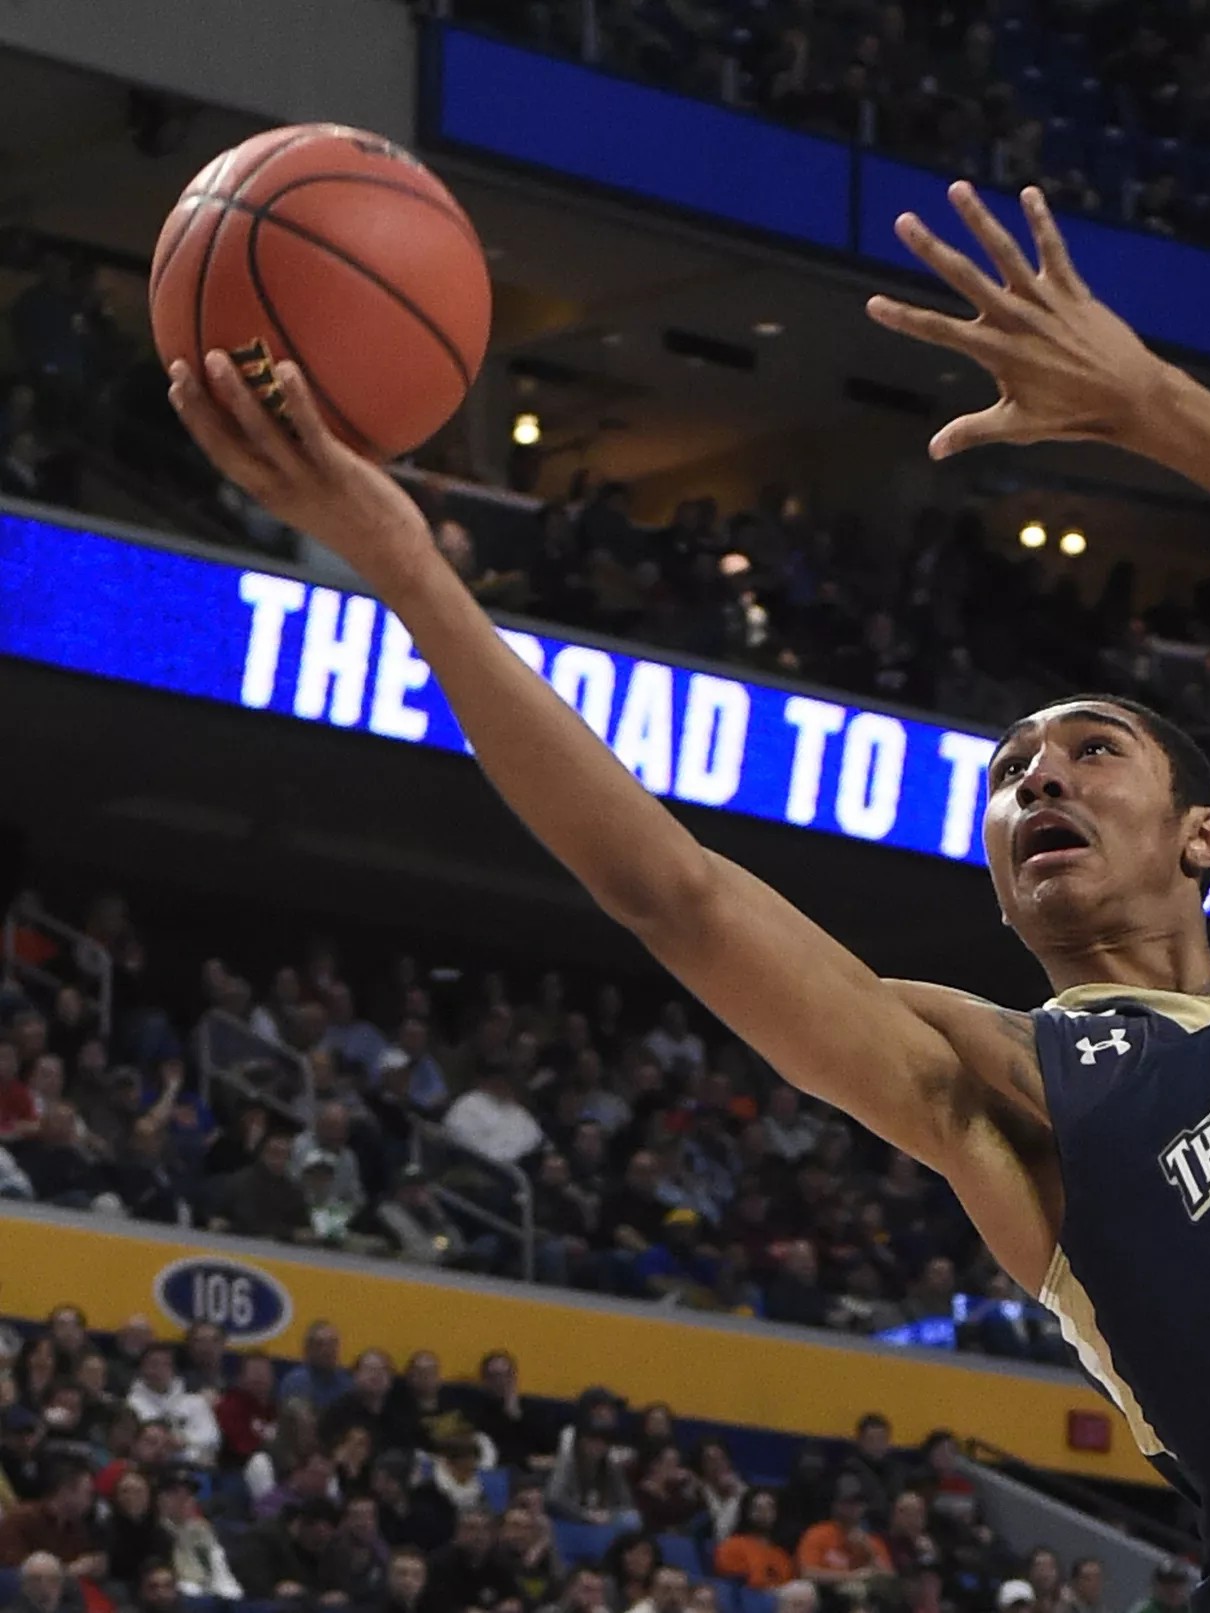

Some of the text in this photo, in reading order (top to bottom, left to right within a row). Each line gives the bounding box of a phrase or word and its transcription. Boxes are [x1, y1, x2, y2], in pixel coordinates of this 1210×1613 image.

[238, 571, 431, 742] THE
[464, 626, 751, 807] OAD
[784, 696, 907, 840] TO
[938, 731, 998, 860] T
[192, 1272, 254, 1328] 106
